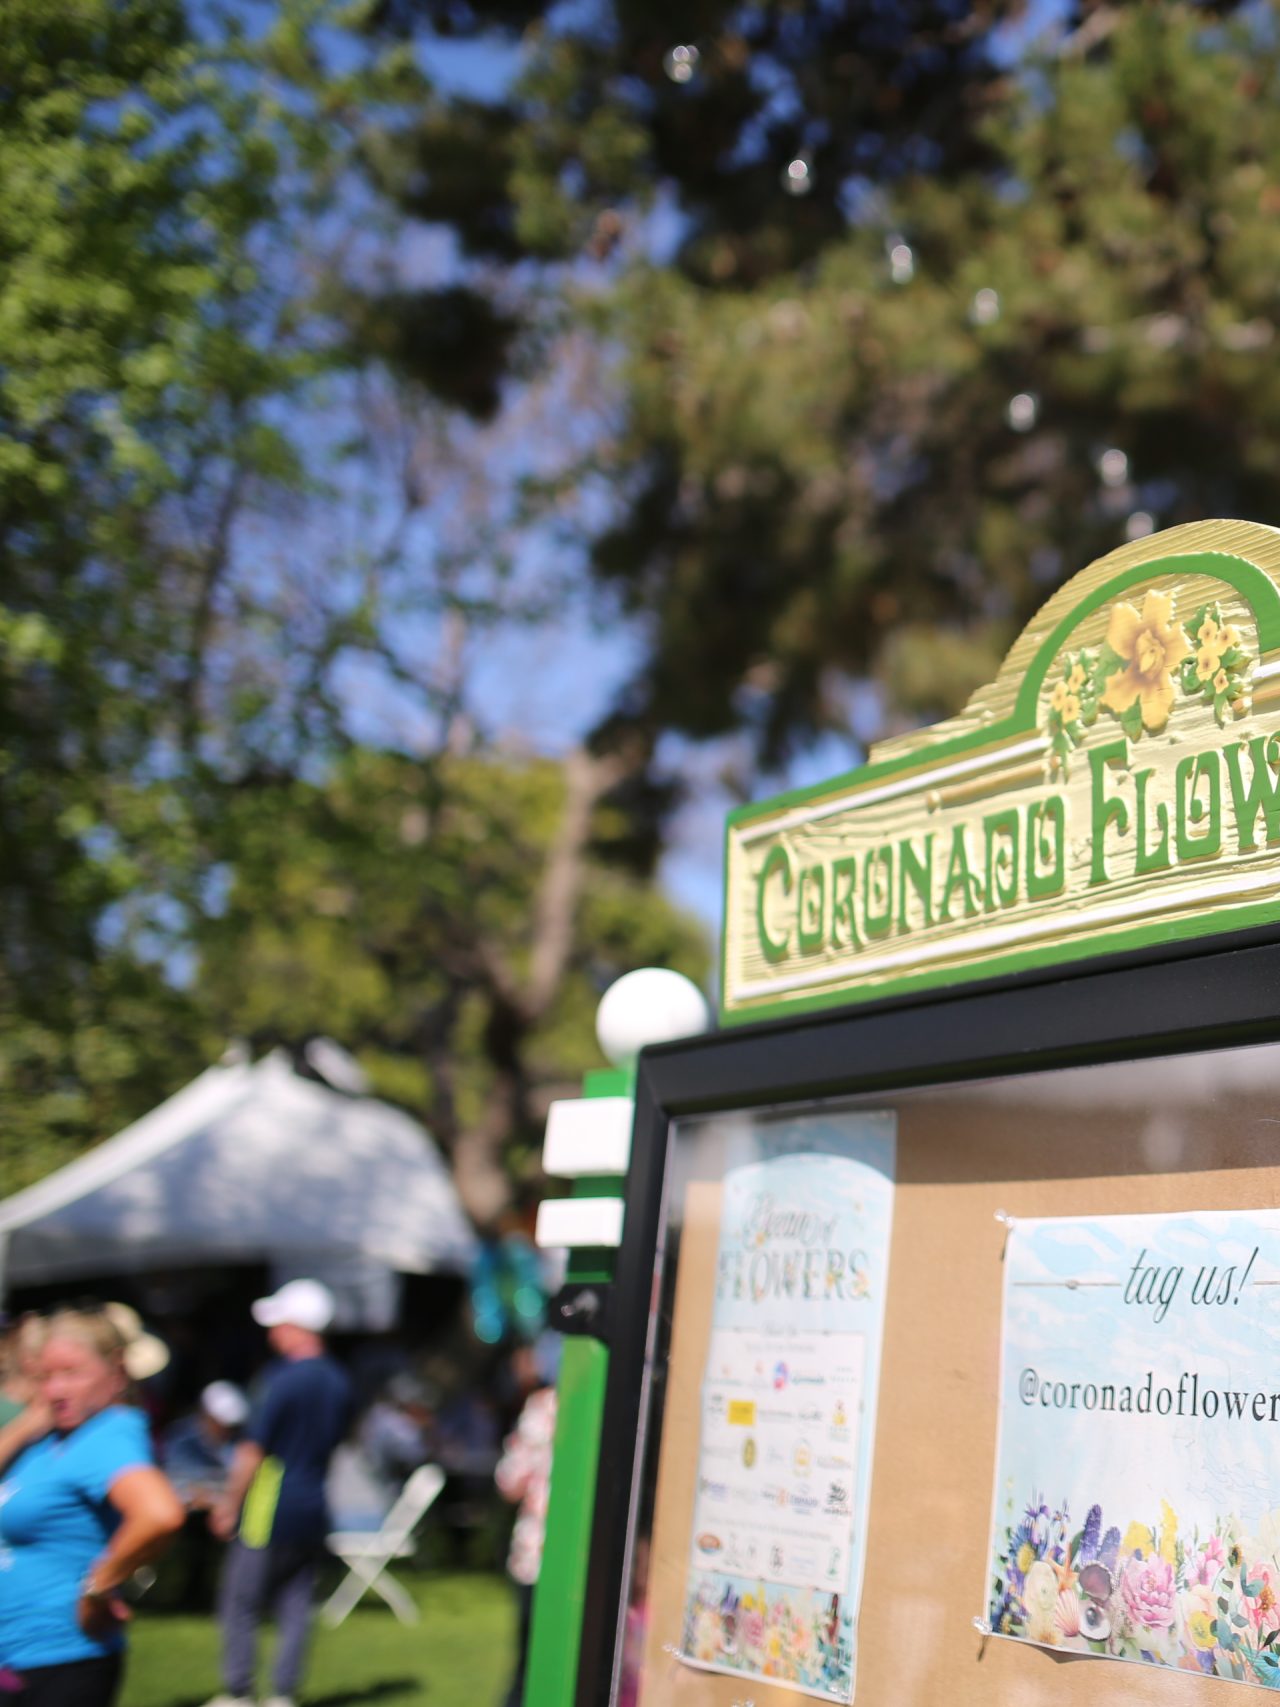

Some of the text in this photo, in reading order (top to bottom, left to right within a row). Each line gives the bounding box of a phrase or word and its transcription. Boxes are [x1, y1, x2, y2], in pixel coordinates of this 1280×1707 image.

[756, 793, 1064, 962] CORONADO
[1124, 1246, 1258, 1323] tag us!
